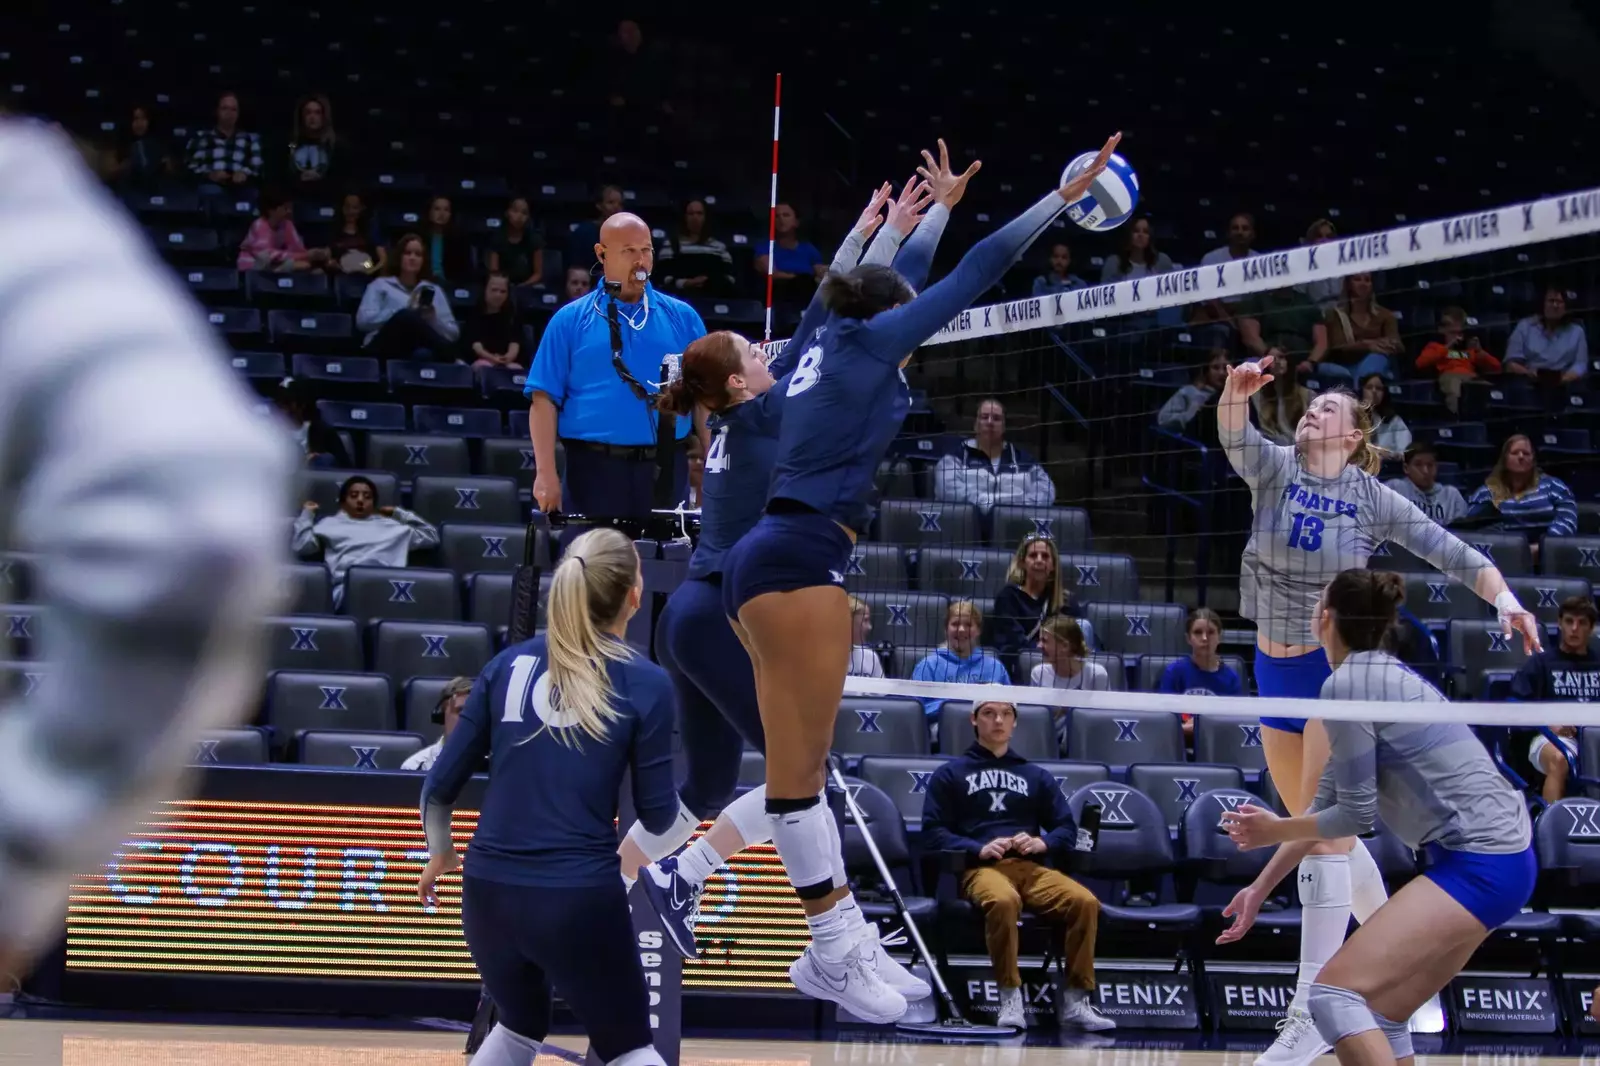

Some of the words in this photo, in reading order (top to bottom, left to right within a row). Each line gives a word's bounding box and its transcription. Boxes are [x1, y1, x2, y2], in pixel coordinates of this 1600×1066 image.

[764, 341, 789, 360] XAVI
[938, 311, 972, 334] VIER
[983, 308, 992, 328] X
[1004, 300, 1041, 324] XAVIER
[1055, 294, 1063, 316] X
[1077, 285, 1116, 310] XAVIER
[1131, 280, 1141, 302] X
[1156, 270, 1199, 298] XAVIER
[1216, 264, 1226, 288] X
[1241, 253, 1290, 281] XAVIER
[1308, 246, 1318, 271] X
[1337, 233, 1389, 265] XAVIER
[1409, 226, 1421, 251] X
[1442, 212, 1500, 246] XAVIER
[1522, 202, 1535, 232] X
[1557, 192, 1600, 224] XAVI
[705, 425, 731, 473] 4
[1286, 512, 1325, 552] 13
[1551, 671, 1600, 689] XAVIE
[965, 769, 1029, 797] XAVIER
[988, 791, 1008, 812] X
[967, 980, 1052, 1003] FEIX
[1102, 1008, 1145, 1016] INNOVATIVE
[1227, 1009, 1269, 1018] INNOVATIVE
[1465, 1011, 1506, 1021] INNOVATIVE
[1506, 1013, 1546, 1022] MATERIALS
